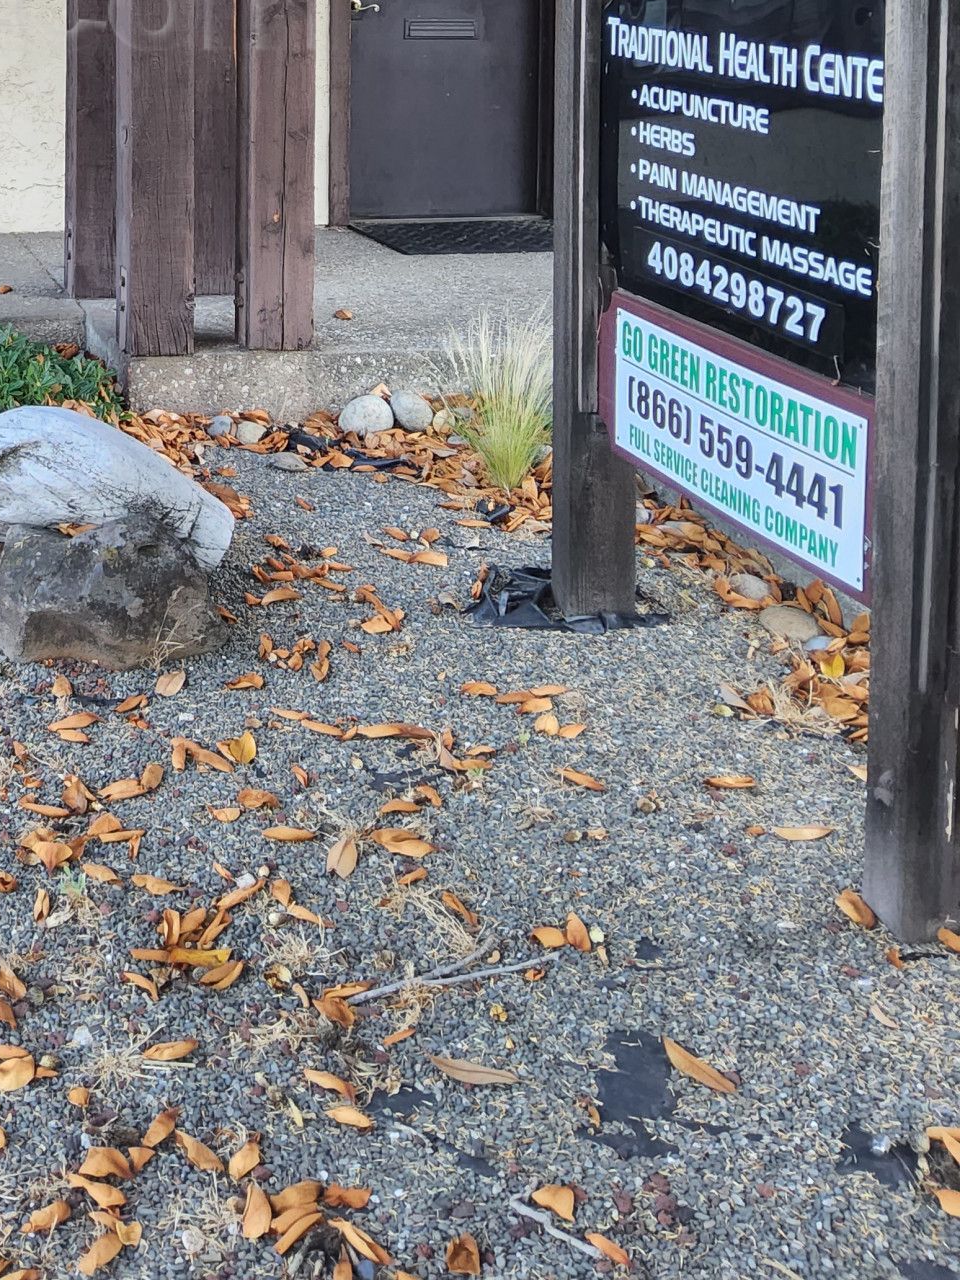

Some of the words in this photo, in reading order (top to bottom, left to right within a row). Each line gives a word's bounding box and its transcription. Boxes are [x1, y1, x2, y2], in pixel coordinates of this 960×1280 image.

[607, 16, 714, 74] TRADITIONAL
[719, 31, 798, 88] HEALTH
[804, 44, 884, 103] CENTE
[639, 84, 769, 134] ACUPUNCTURE
[639, 121, 696, 156] HERBS
[638, 195, 757, 257] THERAPEUTIC
[762, 236, 872, 296] MASSAGE
[639, 158, 677, 191] PAIN
[681, 171, 821, 233] MANAGEMENT
[647, 241, 826, 342] 4084298727
[622, 320, 643, 363] GO
[648, 333, 700, 394] GREEN
[705, 360, 858, 470] RESTORATION
[628, 375, 691, 445] (866)
[699, 414, 844, 530] 559-4441
[629, 424, 651, 458] FULL
[653, 438, 699, 488] SERVICE
[700, 468, 761, 526] CLEANING
[764, 505, 839, 567] COMPANY
